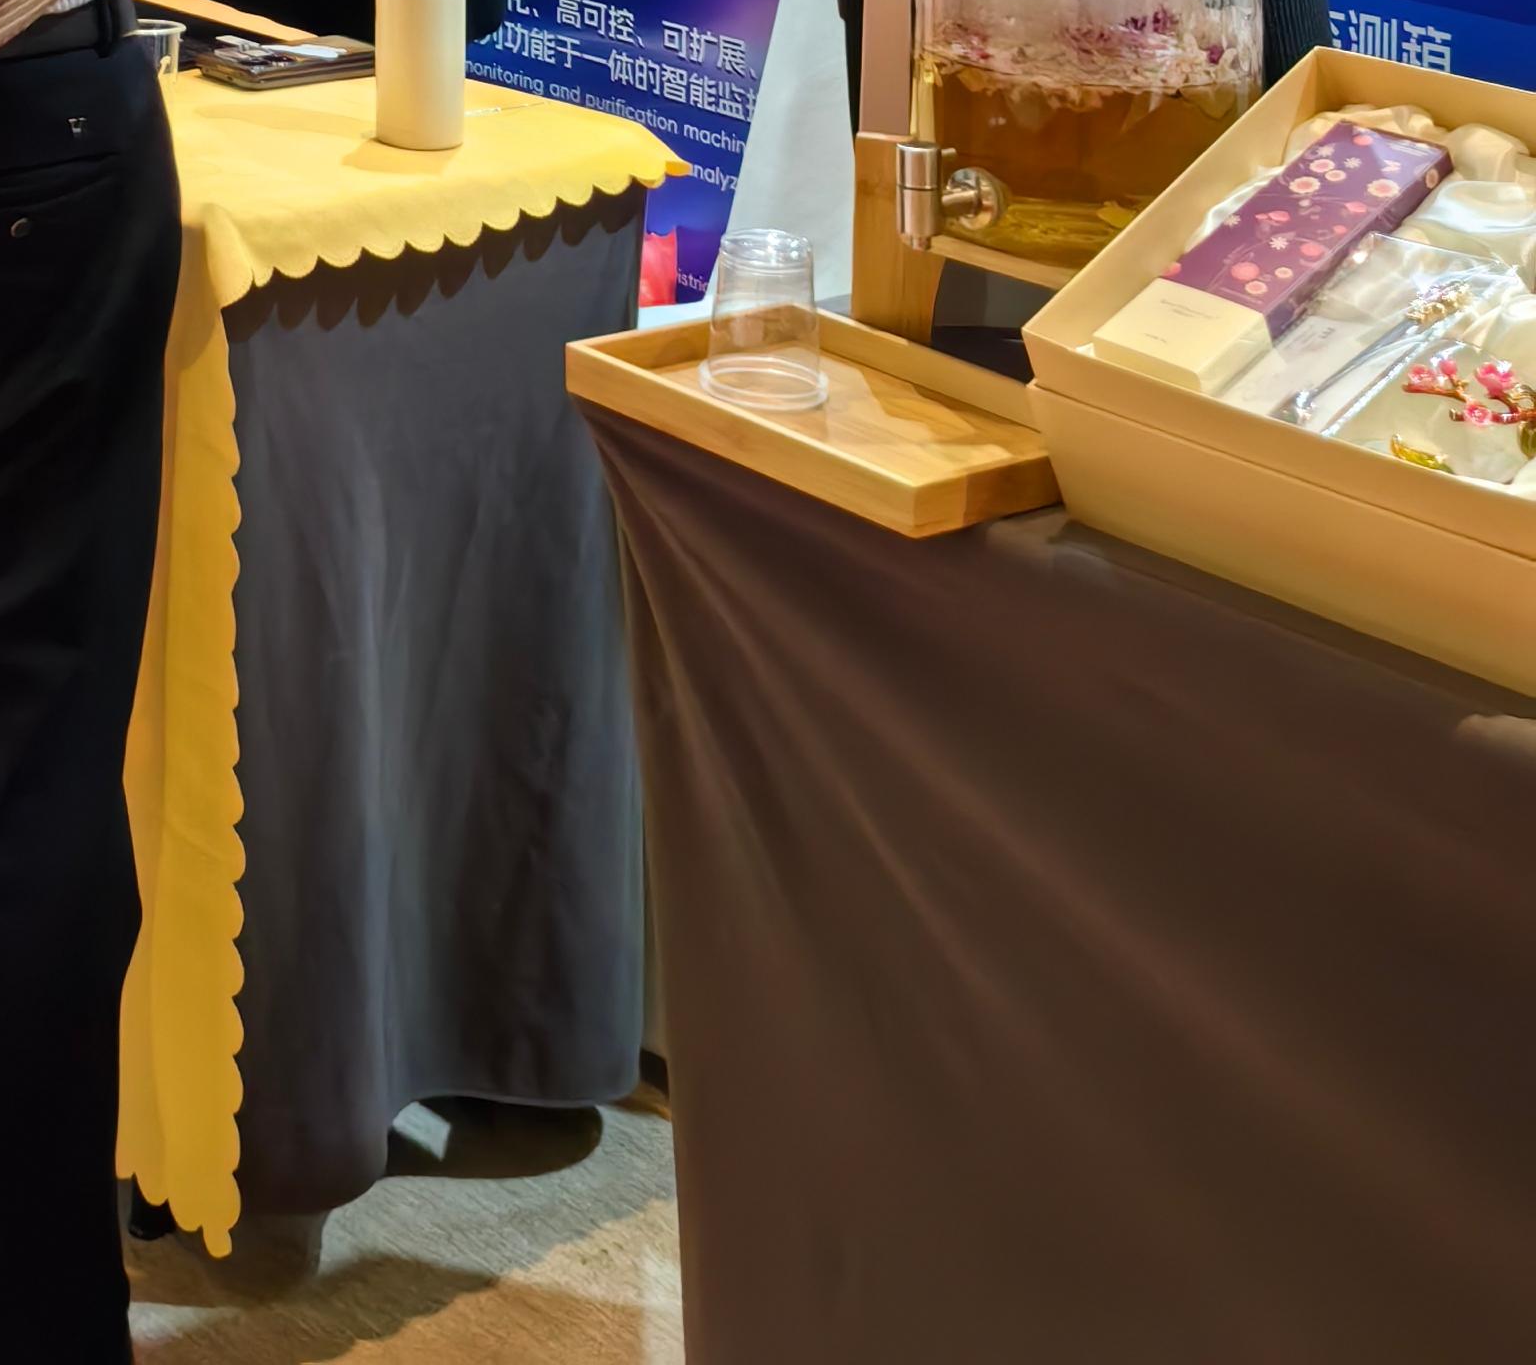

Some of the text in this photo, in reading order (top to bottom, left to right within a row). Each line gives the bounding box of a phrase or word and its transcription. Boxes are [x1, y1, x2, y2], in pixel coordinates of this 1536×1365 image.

[550, 82, 581, 103] and
[585, 93, 678, 135] purification
[693, 164, 738, 192] nalyz
